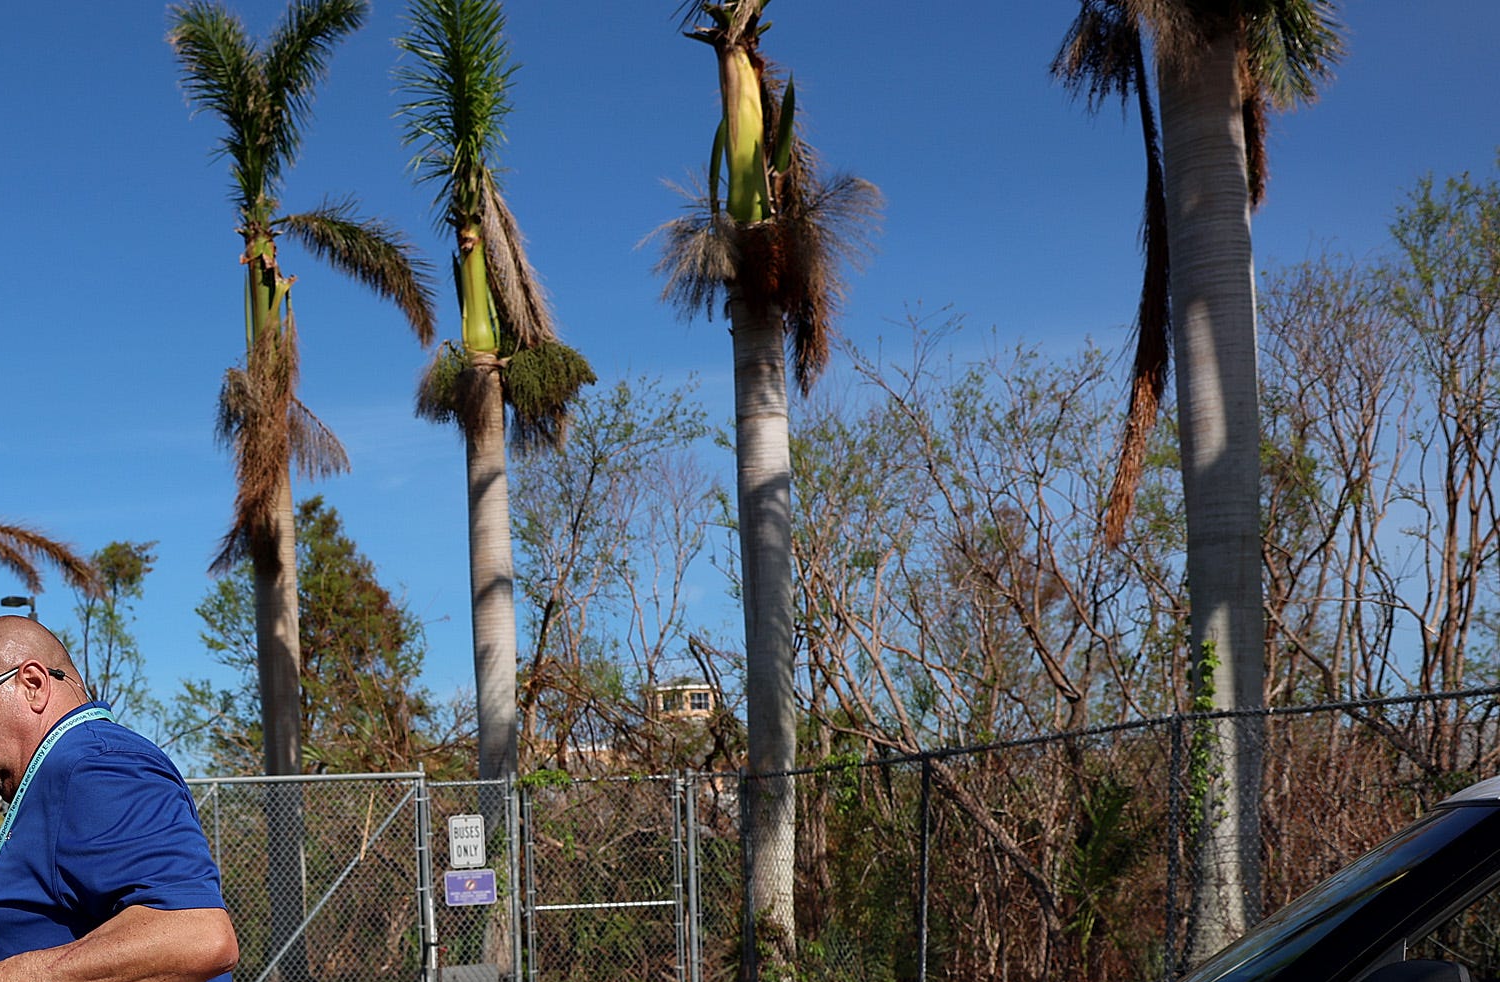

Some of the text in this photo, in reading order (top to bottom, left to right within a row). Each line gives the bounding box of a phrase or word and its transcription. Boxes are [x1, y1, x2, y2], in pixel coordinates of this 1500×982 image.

[22, 773, 31, 787] Lee
[29, 750, 45, 773] County
[42, 731, 59, 750] E-Role
[58, 713, 87, 732] Response
[10, 794, 21, 812] Team
[454, 826, 480, 839] BUSES
[457, 844, 479, 858] ONLY
